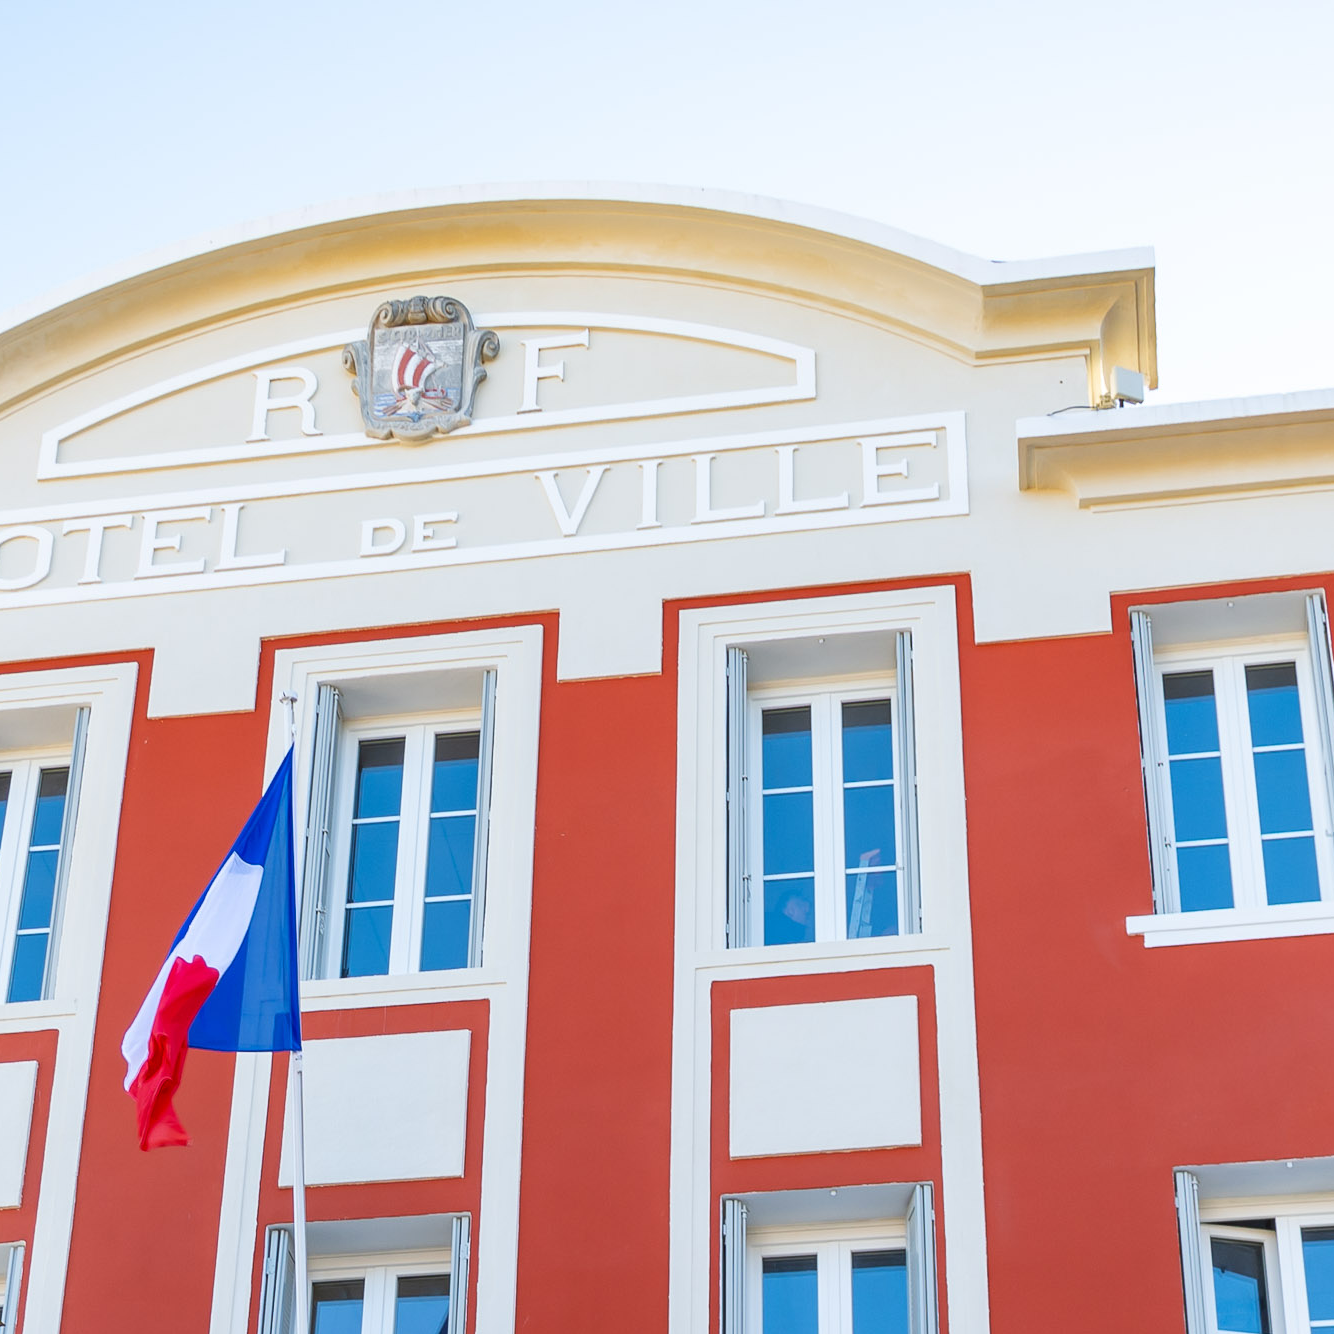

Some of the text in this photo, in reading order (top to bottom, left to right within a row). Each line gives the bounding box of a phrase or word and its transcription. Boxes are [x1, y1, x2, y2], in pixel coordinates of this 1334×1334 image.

[246, 328, 590, 443] R F
[359, 511, 459, 558] DE
[534, 430, 941, 538] VILLE
